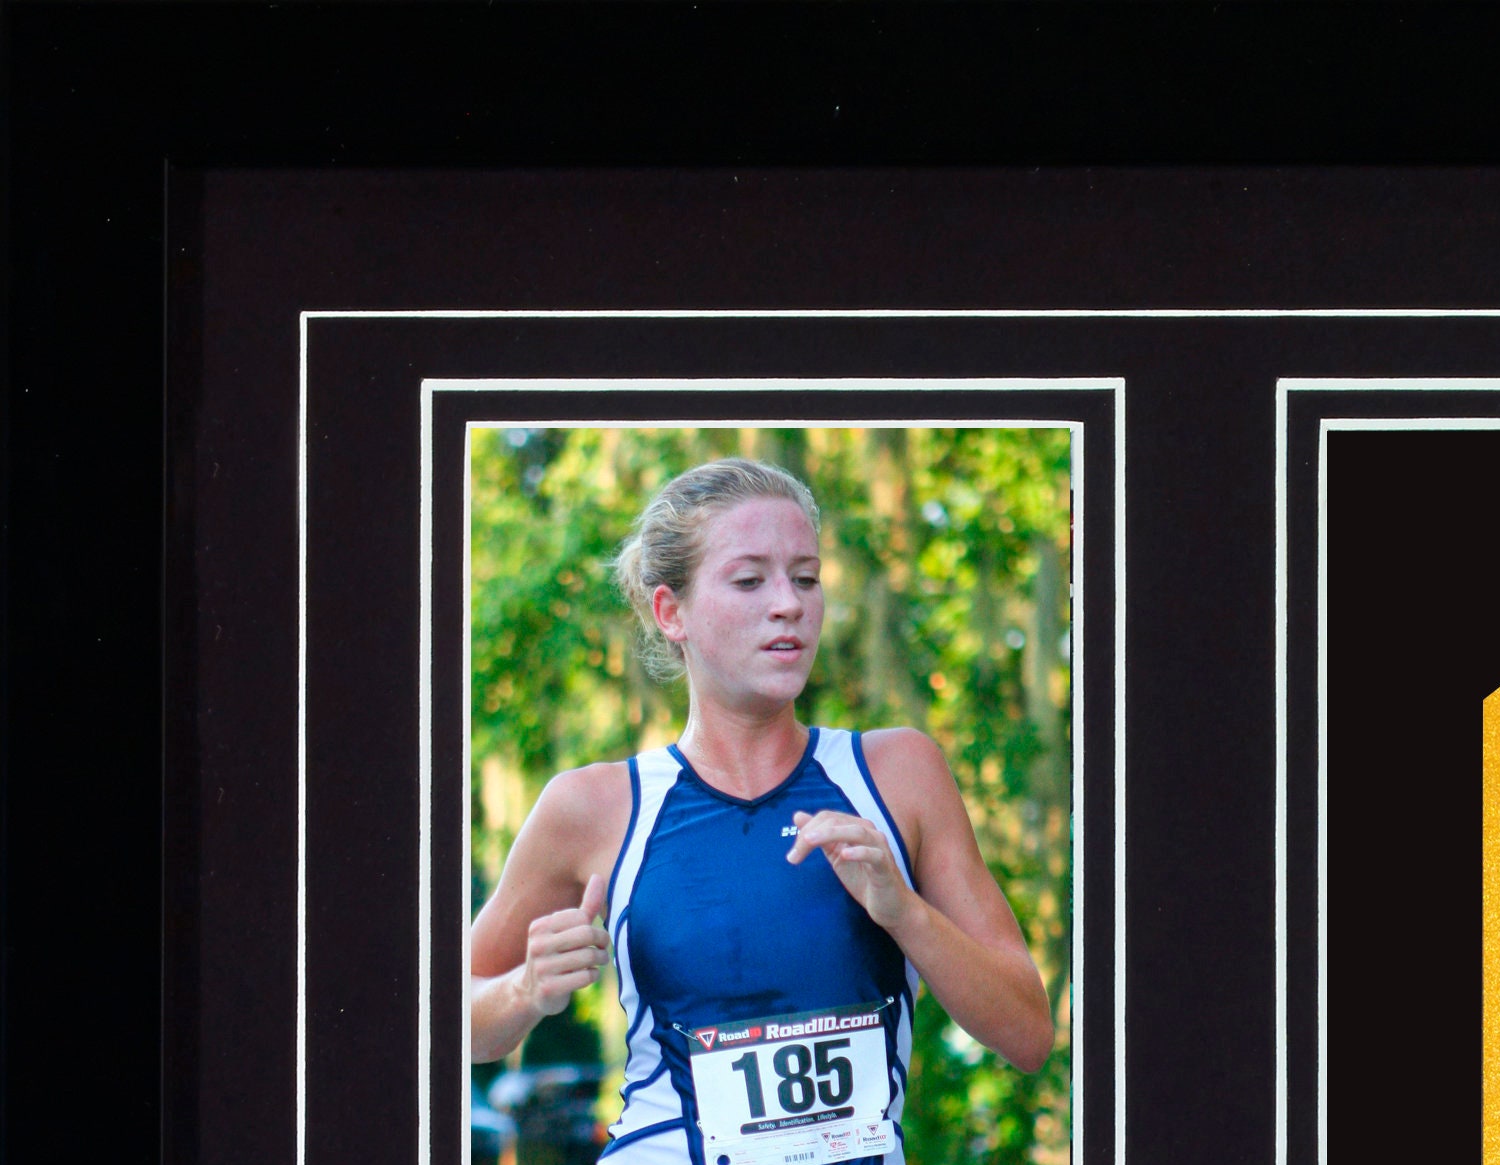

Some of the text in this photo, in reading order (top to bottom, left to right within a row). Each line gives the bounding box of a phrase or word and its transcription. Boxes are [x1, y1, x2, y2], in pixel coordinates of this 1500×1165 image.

[718, 1012, 880, 1043] RoadID RoadID.com
[732, 1037, 853, 1119] 185
